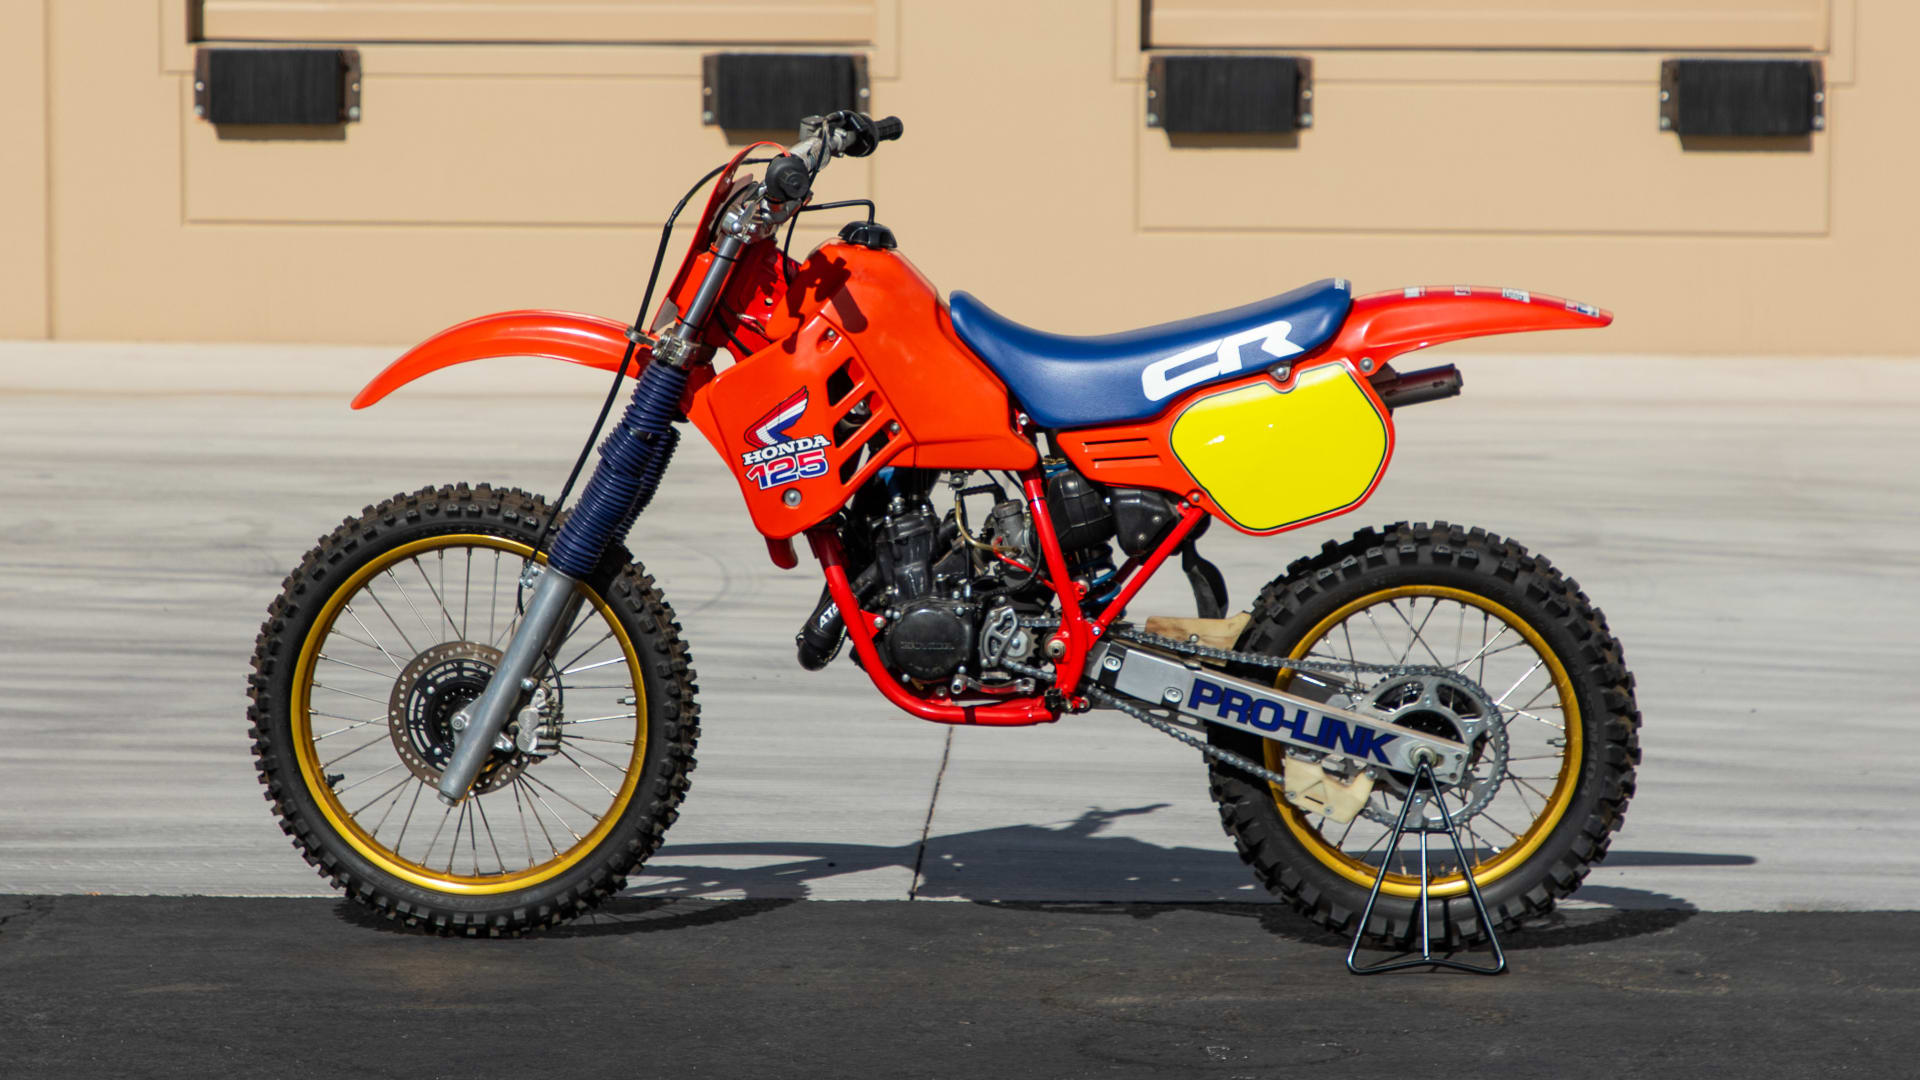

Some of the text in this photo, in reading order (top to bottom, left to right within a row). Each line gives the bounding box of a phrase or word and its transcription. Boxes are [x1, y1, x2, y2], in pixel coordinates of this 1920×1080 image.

[1141, 320, 1305, 401] CR
[742, 434, 831, 466] HONDA
[746, 448, 829, 490] 125
[1187, 678, 1401, 766] PRO-LINK
